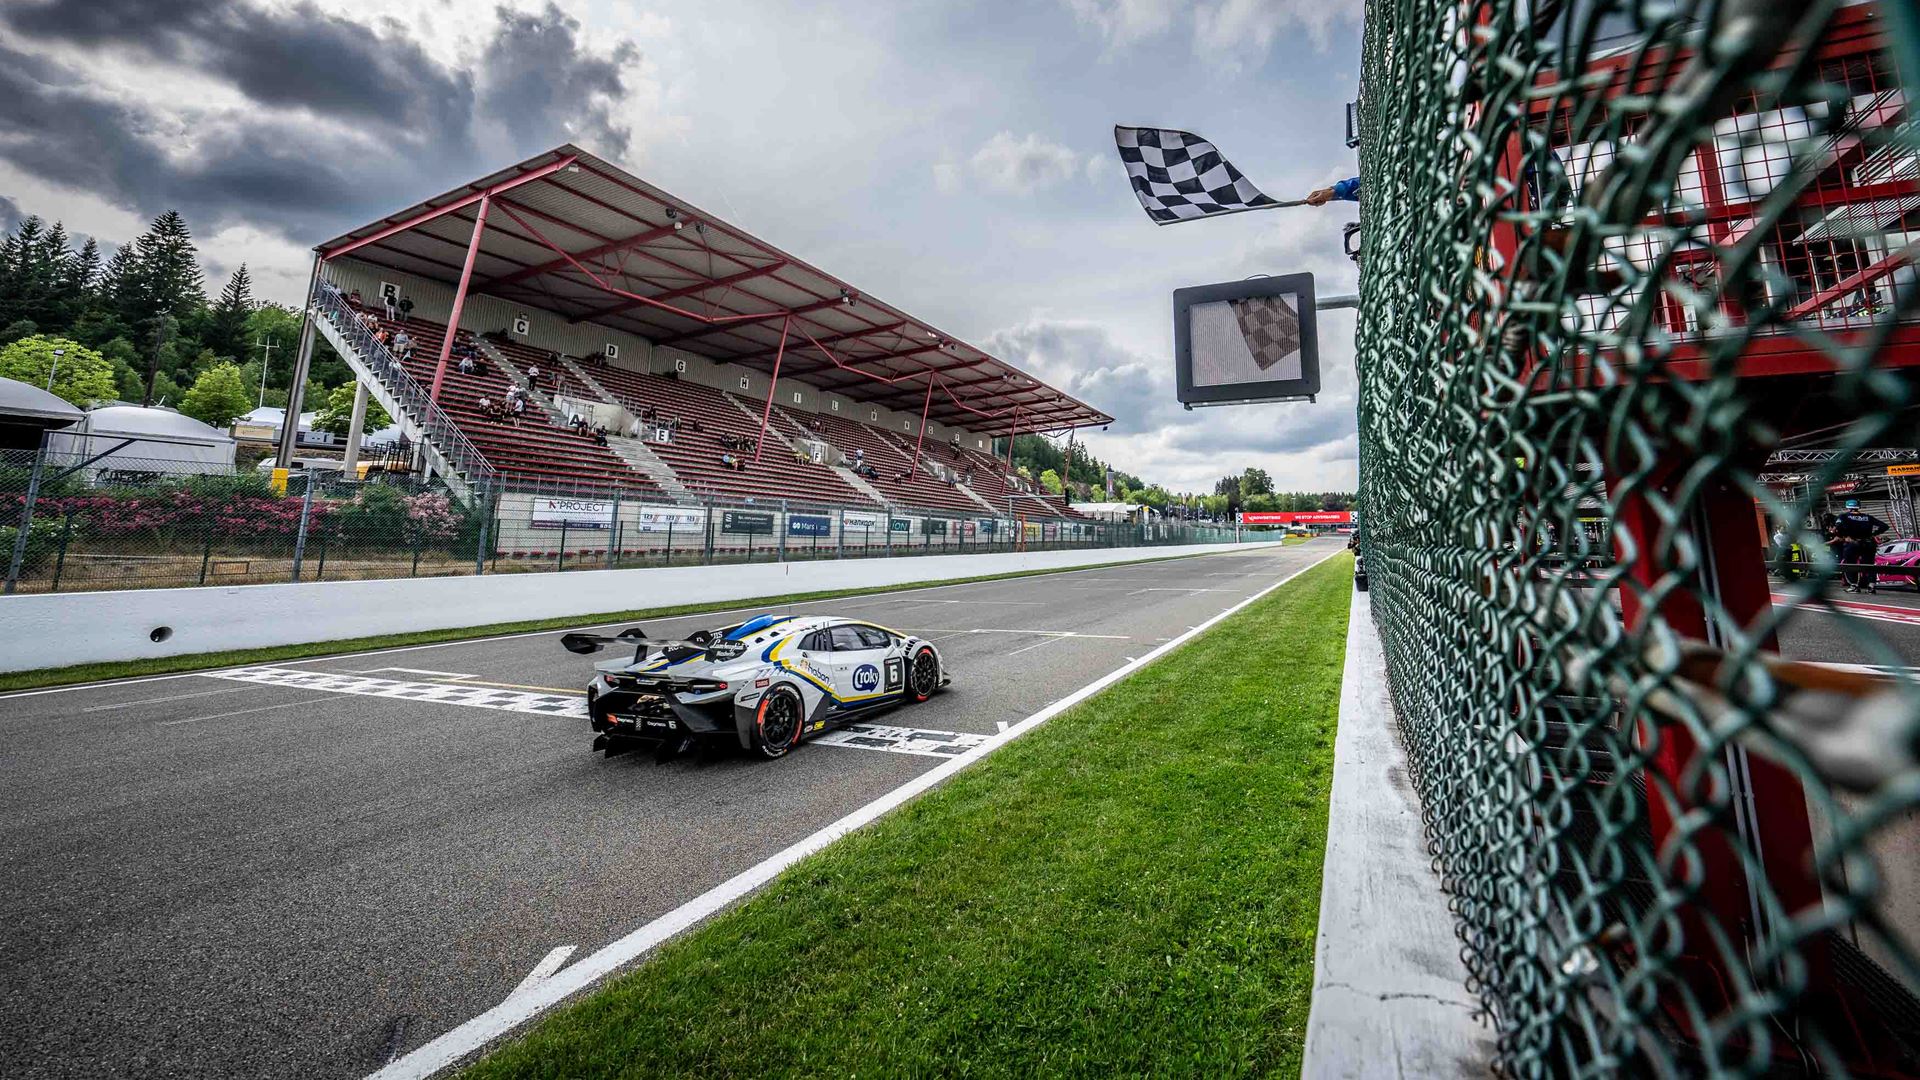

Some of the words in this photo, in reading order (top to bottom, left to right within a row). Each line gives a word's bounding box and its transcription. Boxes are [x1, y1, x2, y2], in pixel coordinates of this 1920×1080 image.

[384, 284, 396, 298] B
[517, 321, 526, 333] C
[608, 345, 616, 356] D
[677, 361, 684, 371] G
[741, 378, 748, 388] H
[569, 414, 581, 425] A
[659, 430, 665, 441] E
[854, 668, 879, 688] Croky
[890, 664, 898, 683] 6
[668, 720, 677, 729] 6
